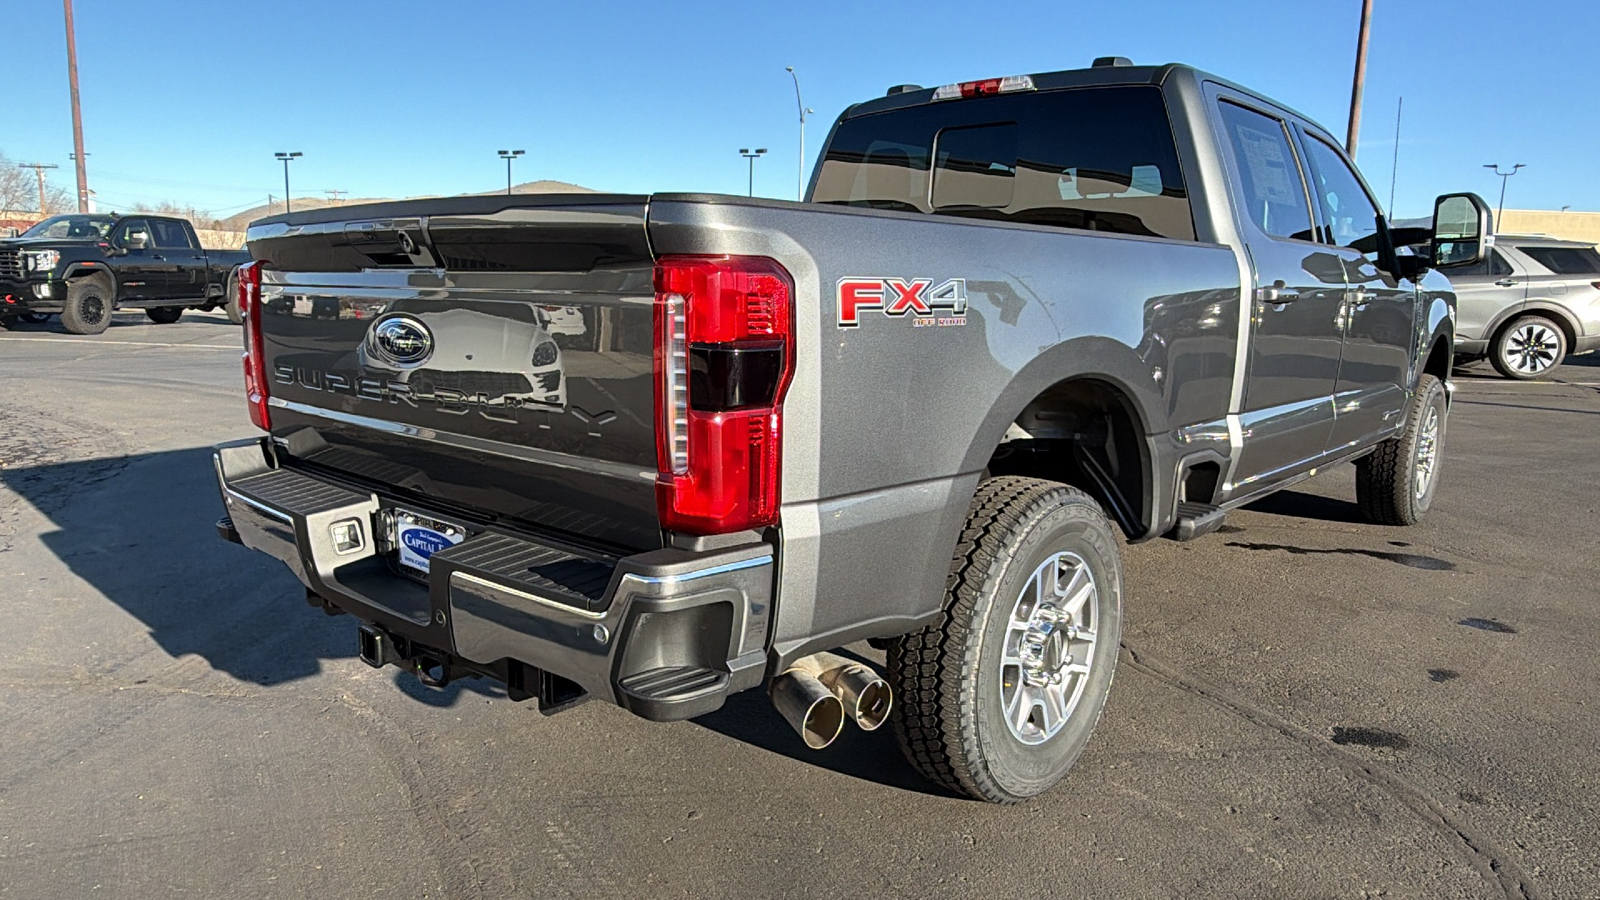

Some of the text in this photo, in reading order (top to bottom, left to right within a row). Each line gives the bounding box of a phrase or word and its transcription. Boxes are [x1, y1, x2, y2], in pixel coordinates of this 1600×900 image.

[836, 276, 968, 329] FX4
[274, 364, 618, 438] SUPER DUTY
